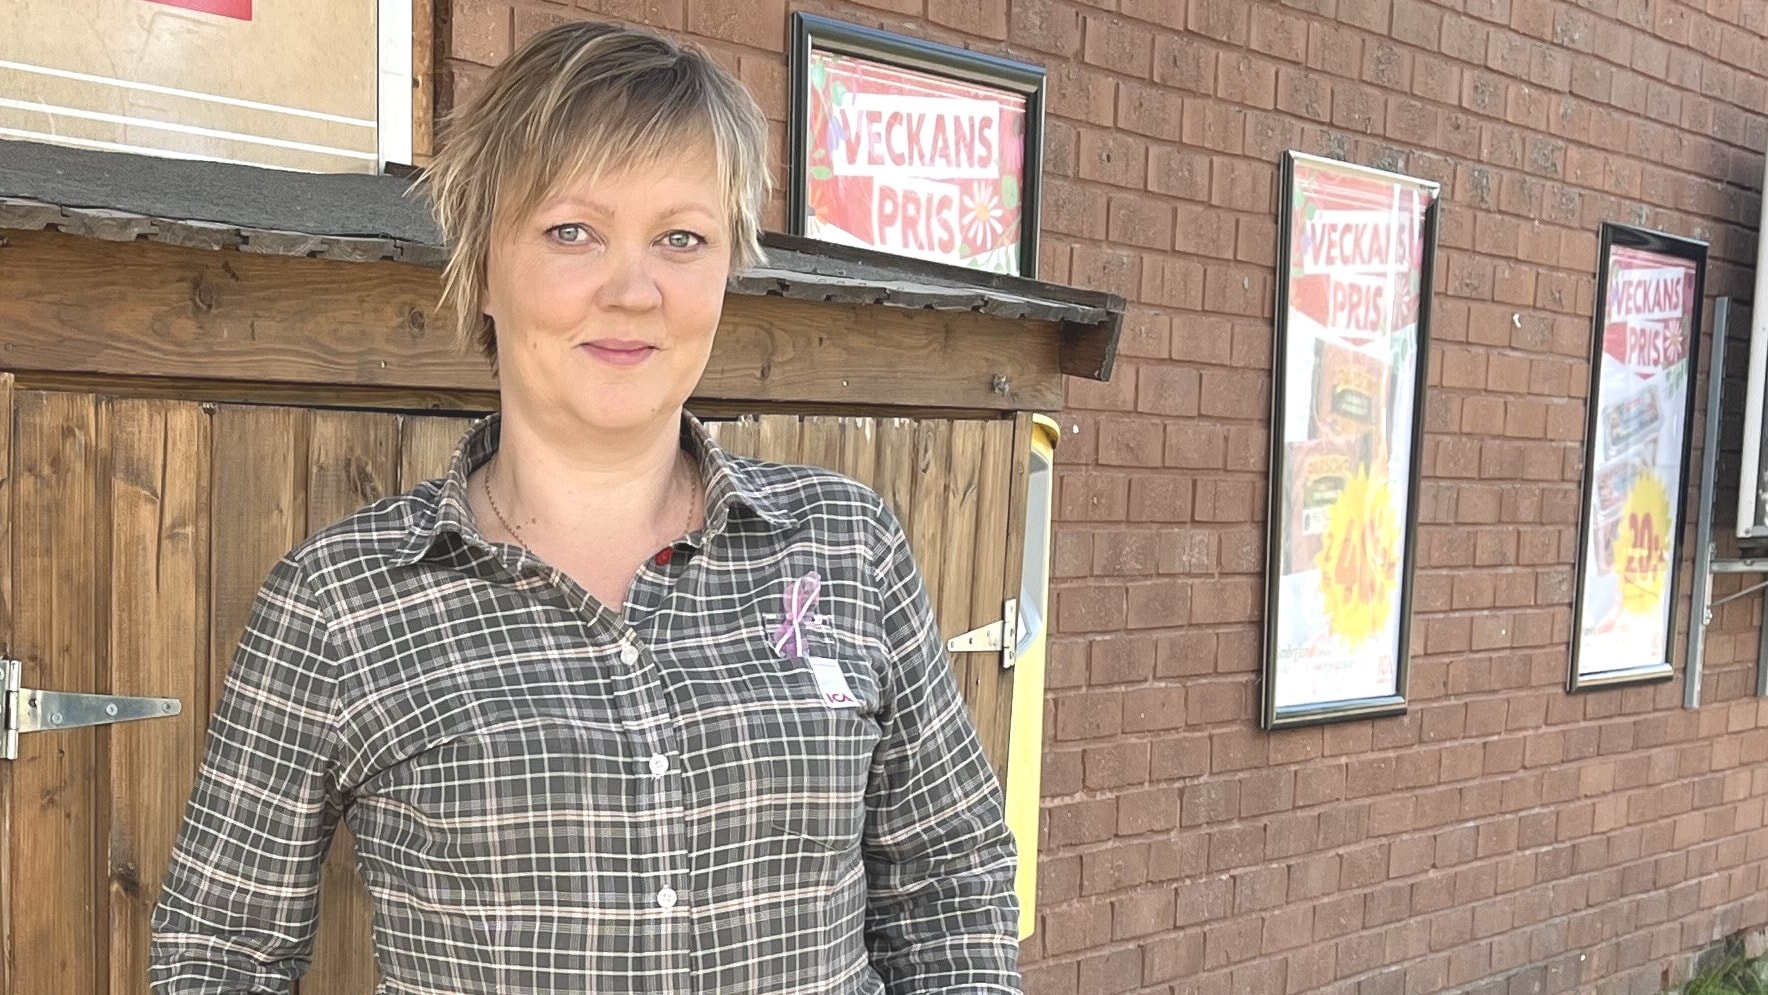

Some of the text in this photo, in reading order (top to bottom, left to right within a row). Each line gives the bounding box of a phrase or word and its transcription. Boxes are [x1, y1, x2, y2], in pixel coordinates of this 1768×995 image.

[839, 109, 993, 169] VECKANS
[878, 184, 955, 254] PRIS
[1331, 280, 1384, 333] PRIS
[1615, 277, 1681, 315] VECKANS
[1627, 326, 1660, 367] PRIS
[826, 693, 854, 703] ICA
